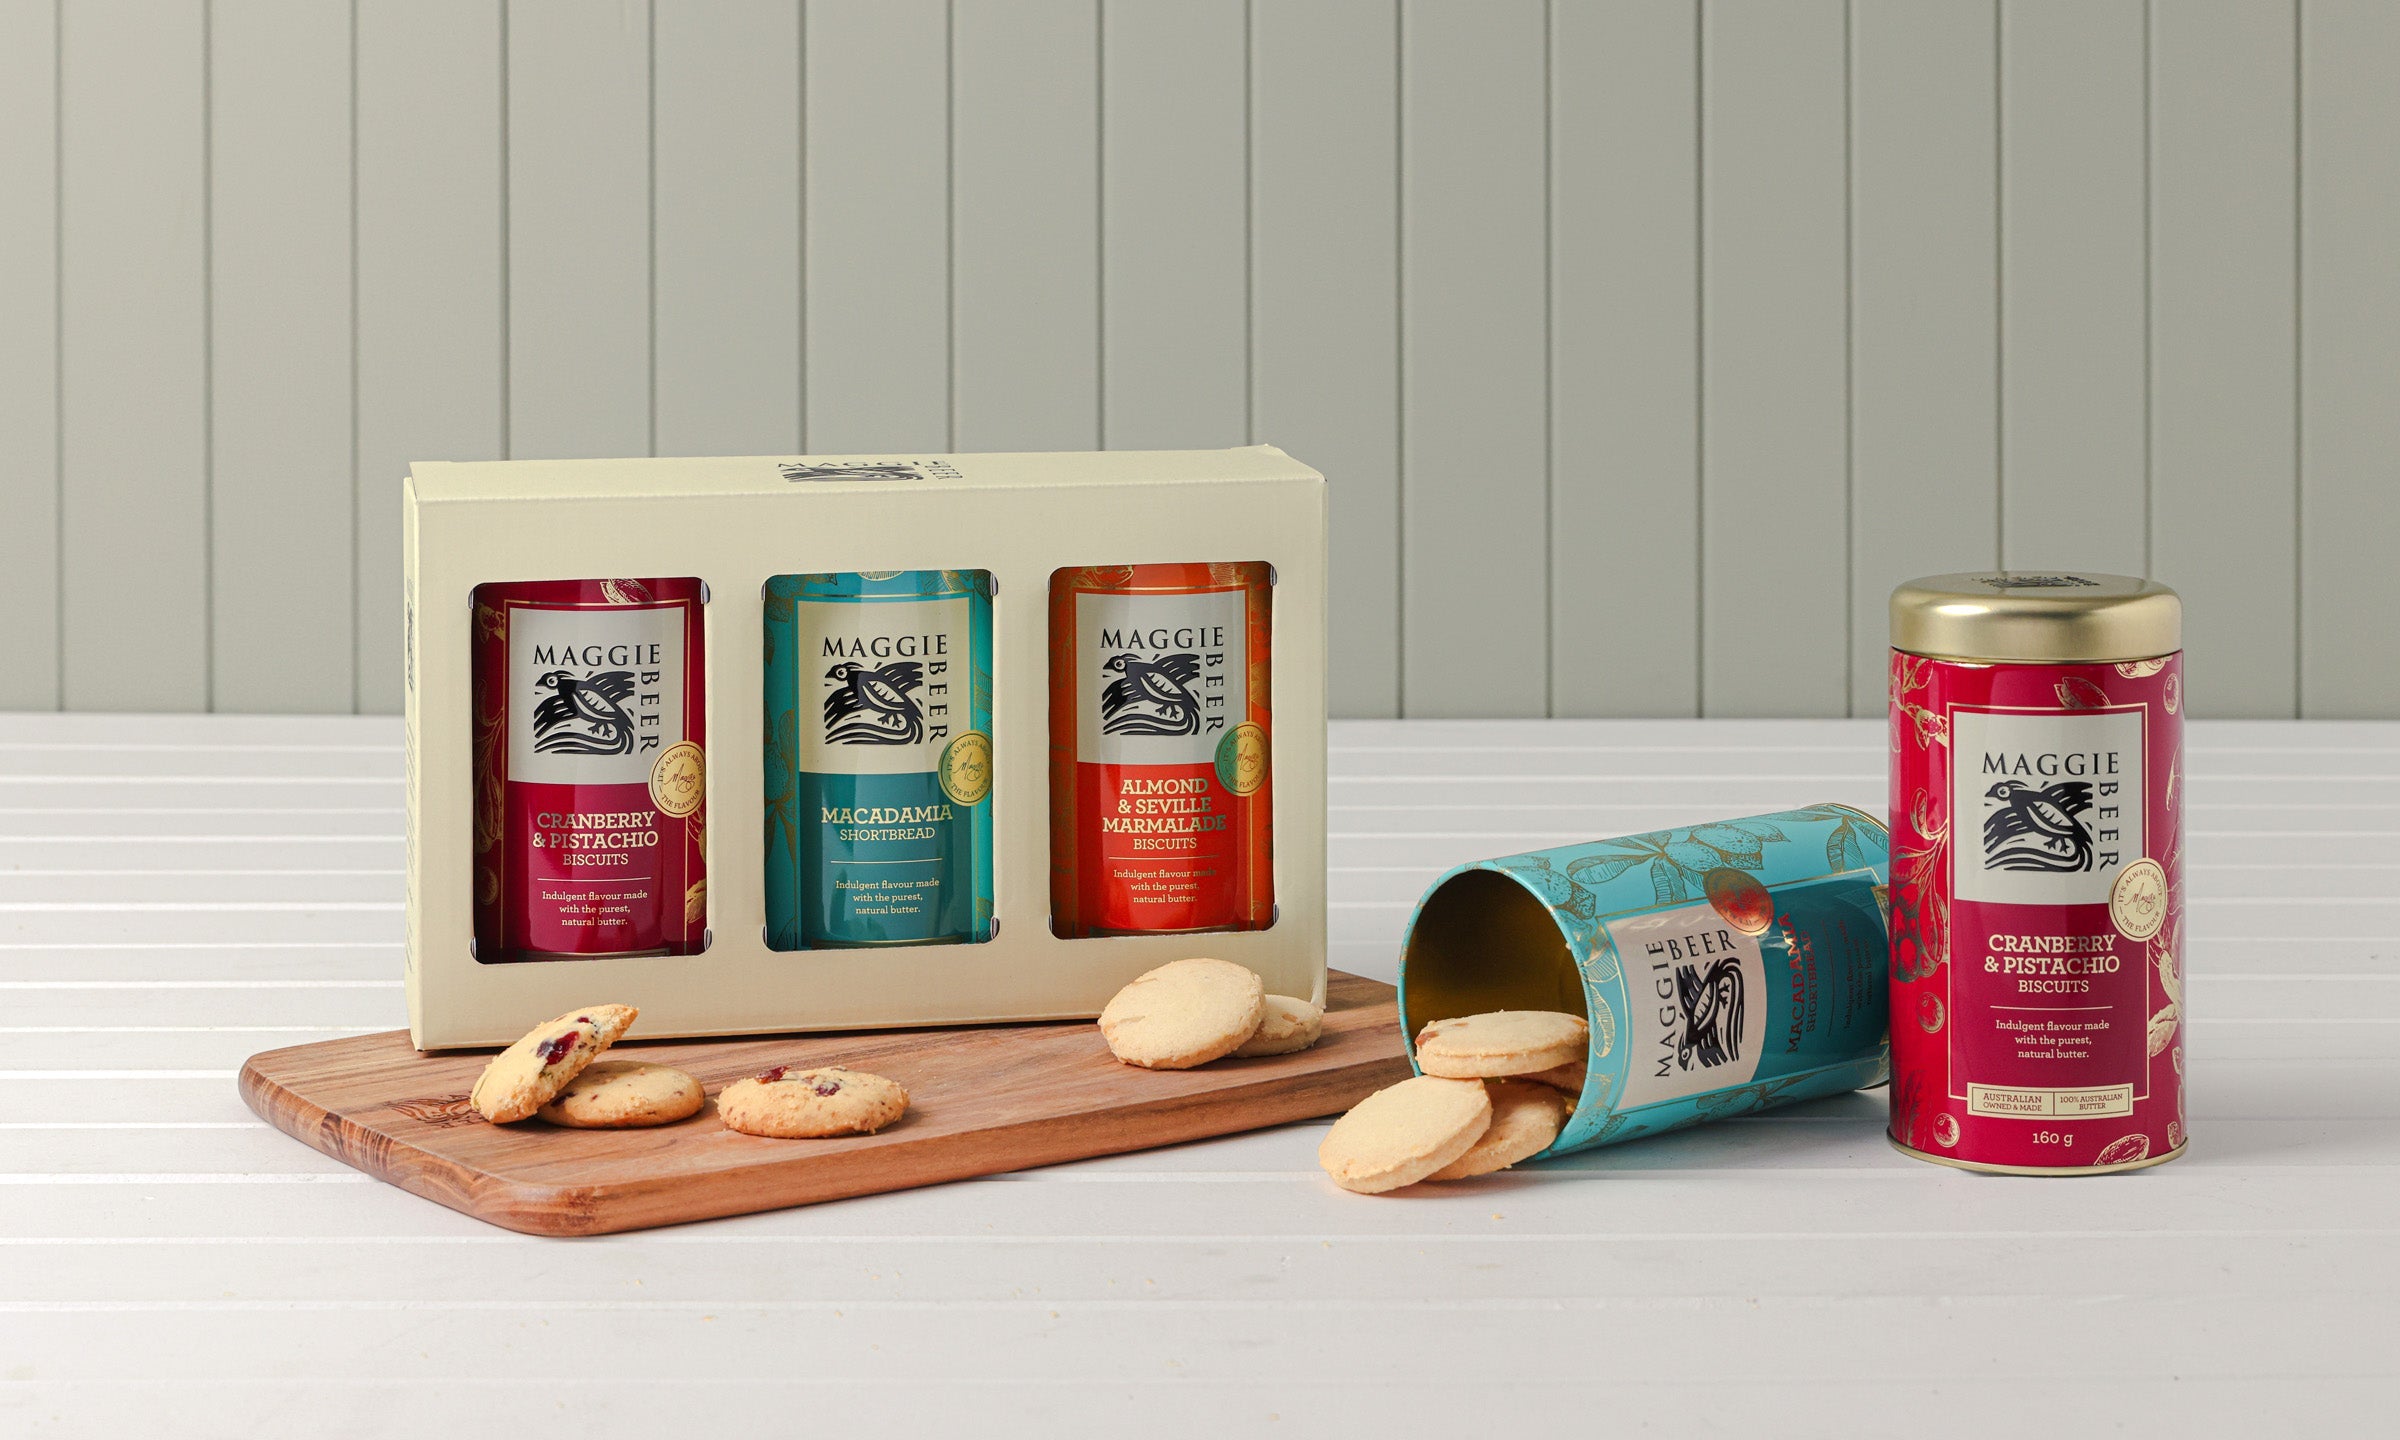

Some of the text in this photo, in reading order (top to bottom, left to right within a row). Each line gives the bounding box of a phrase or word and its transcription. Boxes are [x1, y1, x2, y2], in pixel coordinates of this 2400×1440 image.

[822, 634, 947, 658] MAGGIE
[1100, 626, 1224, 650] MAGGIE
[533, 643, 661, 667] MAGGIE
[928, 660, 948, 744] BEER
[1205, 652, 1224, 735] BEER
[639, 670, 660, 755] BEER
[665, 750, 691, 767] ALWAYS
[1982, 751, 2119, 776] MAGGIE
[1121, 778, 1209, 795] ALMOND
[661, 794, 674, 808] THE
[1118, 797, 1211, 814] & SEVILLE
[537, 811, 656, 829] CRANBERRY
[821, 804, 953, 824] MACADAMIA
[1102, 814, 1226, 834] MARMALADE
[2099, 779, 2119, 872] BEER
[532, 830, 659, 849] & PISTACHIO
[840, 827, 935, 841] SHORTBREAD
[1133, 837, 1197, 850] BISCUITS
[563, 853, 629, 866] BISCUITS
[1113, 869, 1157, 880] Indulgent
[1159, 869, 1191, 878] flavour
[2125, 868, 2151, 886] ALWAYS
[836, 877, 940, 891] Indulgent flavour made
[1131, 882, 1150, 891] with
[1152, 882, 1167, 891] the
[542, 890, 648, 902] Indulgent flavour made
[853, 893, 923, 903] with the purest,
[1133, 894, 1166, 903] natural
[559, 904, 631, 915] with the purest,
[856, 905, 921, 915] natural butter.
[562, 917, 628, 926] natural butter.
[2122, 911, 2160, 932] THE FLAVOUR
[1667, 929, 1737, 960] BEER
[1989, 934, 2117, 953] CRANBERRY
[1984, 955, 2120, 975] & PISTACHIO
[1777, 912, 1805, 1055] MACADAMIA
[1800, 930, 1818, 1033] SHORTBREAD
[2018, 979, 2089, 993] BISCUITS
[1645, 940, 1677, 1077] MAGGIE
[1996, 1019, 2110, 1032] Indulgent flavour made
[2015, 1035, 2092, 1047] with the purest,
[2018, 1049, 2089, 1058] natural butter.
[1983, 1092, 2042, 1104] AUSTRALIAN
[2060, 1093, 2123, 1104] 100% AUSTRALIAN
[2079, 1102, 2106, 1110] BUTTER
[1983, 1103, 2012, 1111] OWNED
[2019, 1104, 2042, 1112] MADE
[2033, 1131, 2074, 1147] 160 g
